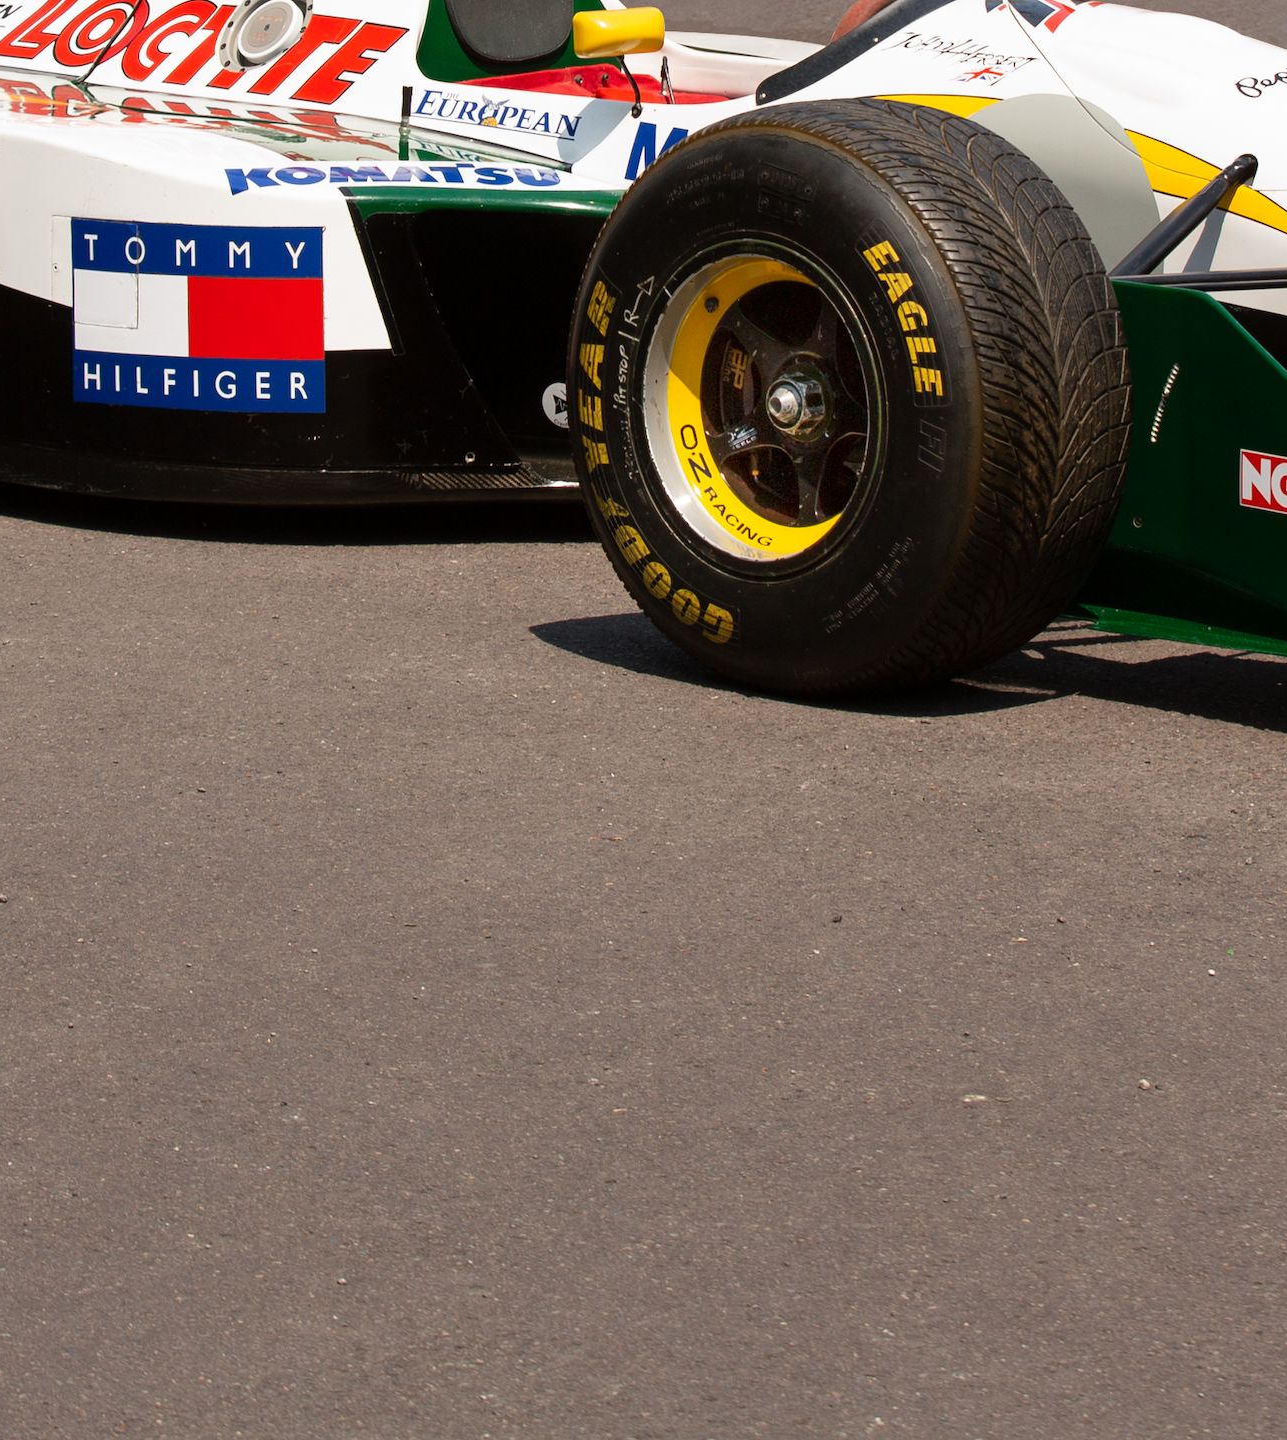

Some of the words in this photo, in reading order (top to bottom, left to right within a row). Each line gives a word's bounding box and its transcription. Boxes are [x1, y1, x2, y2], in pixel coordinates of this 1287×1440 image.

[415, 90, 582, 137] EUROPEAN
[224, 163, 561, 196] KOMATSU
[84, 234, 306, 270] TOMMY
[863, 240, 944, 397] EAGLE
[84, 363, 308, 400] HILFIGER
[704, 487, 774, 547] RACING
